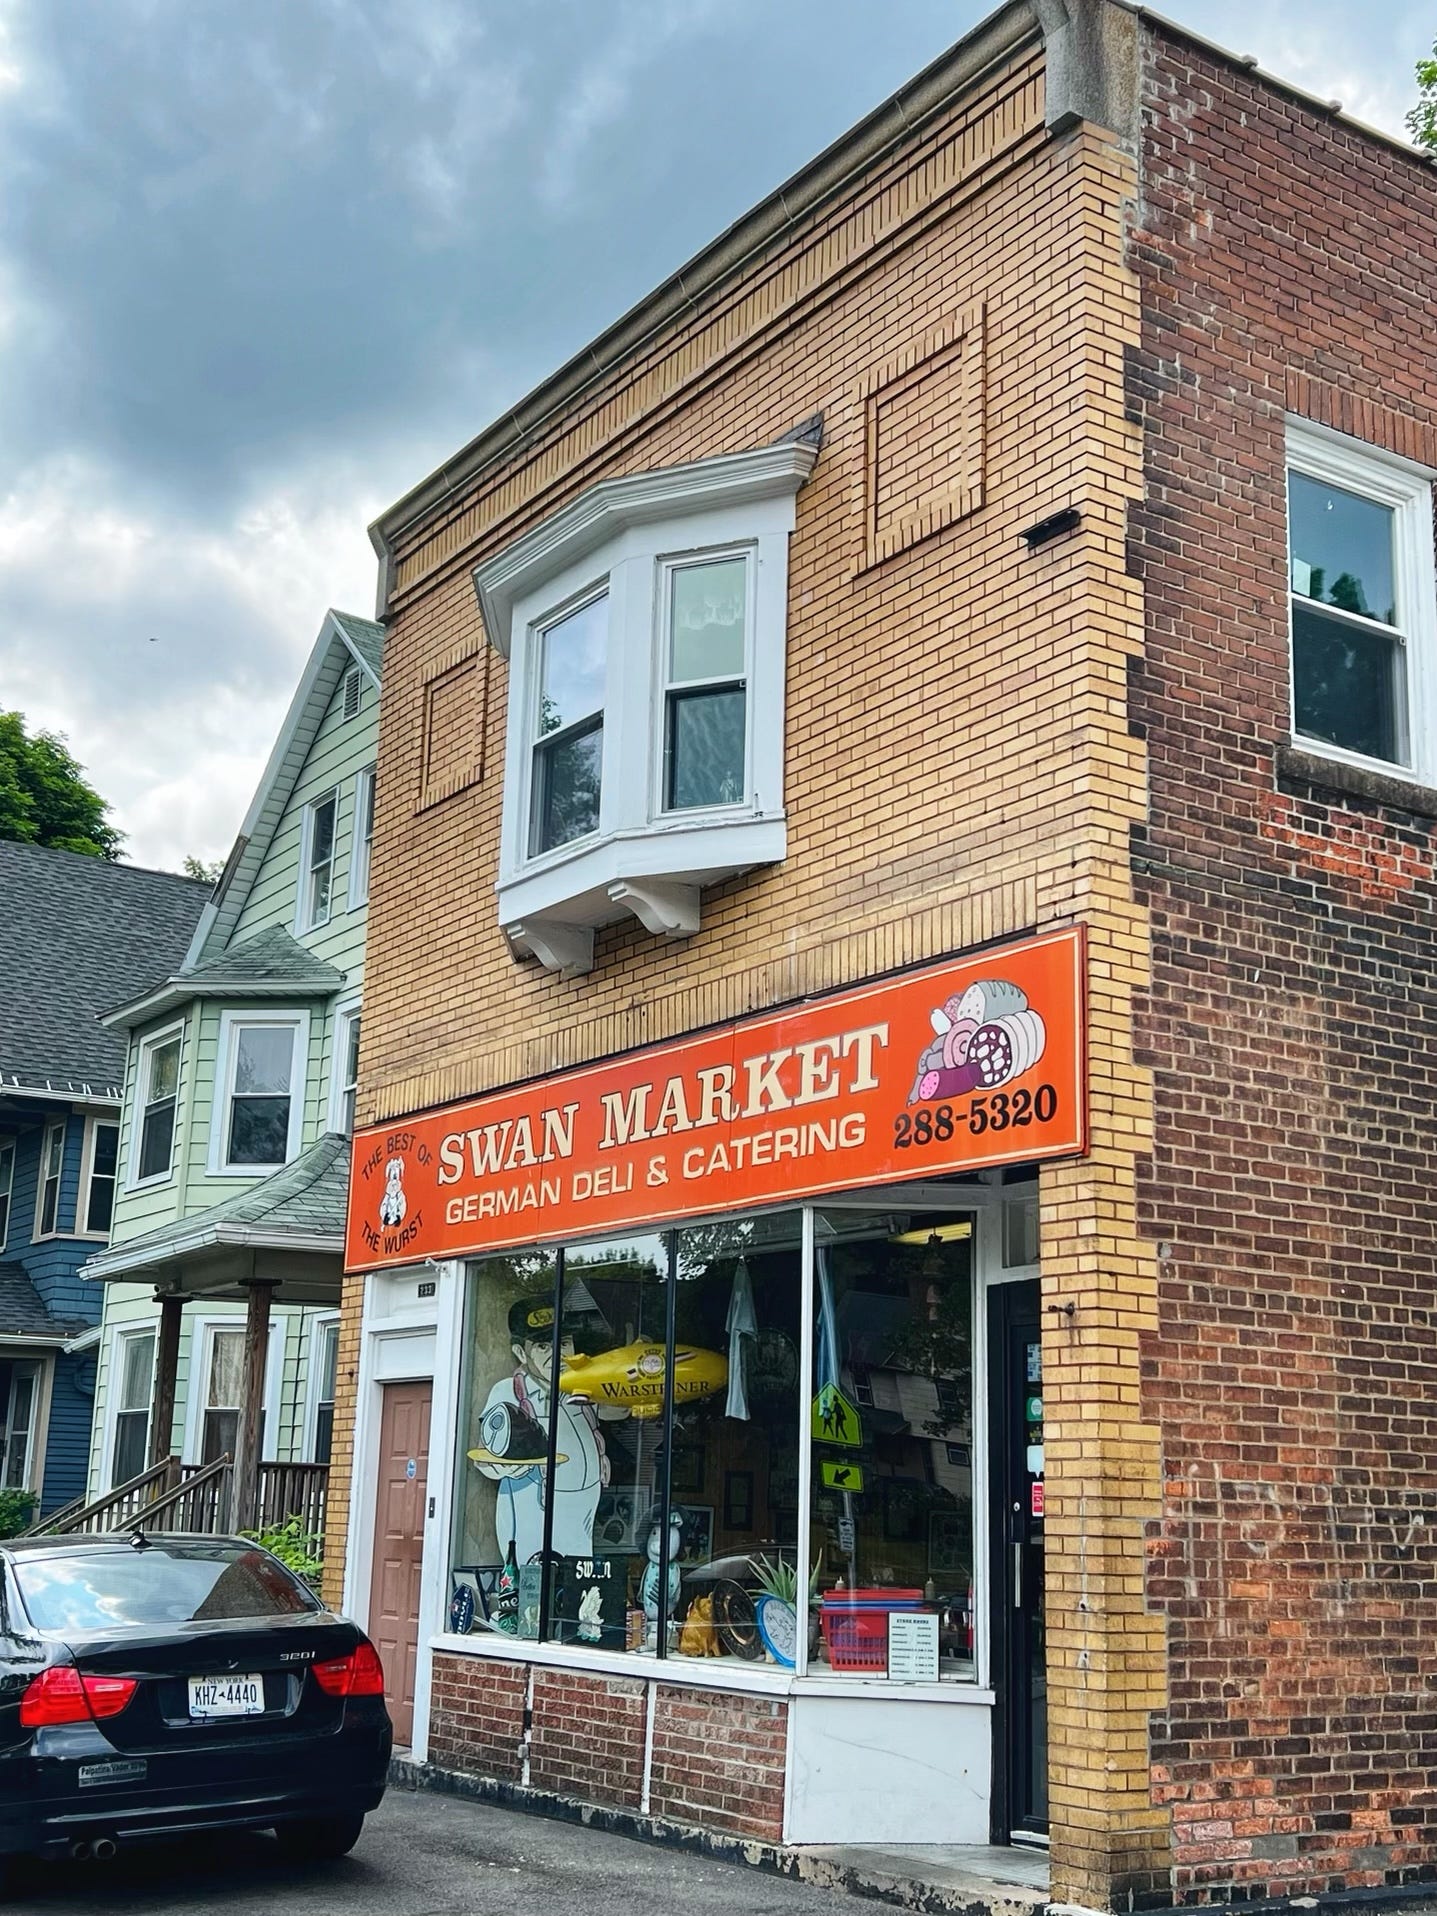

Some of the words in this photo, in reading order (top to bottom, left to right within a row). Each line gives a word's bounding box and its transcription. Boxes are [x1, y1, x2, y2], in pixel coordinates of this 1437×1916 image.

[438, 1102, 579, 1185] SWAN
[598, 1021, 889, 1150] MARKET
[894, 1084, 1057, 1149] 288-5320
[362, 1145, 383, 1181] THE
[387, 1133, 416, 1154] BEST
[418, 1144, 433, 1167] OF
[445, 1177, 561, 1225] GERMAN
[572, 1162, 633, 1201] DELI
[647, 1155, 669, 1187] &
[683, 1113, 866, 1179] CATERING
[361, 1221, 381, 1252] THE
[384, 1210, 424, 1254] WURST
